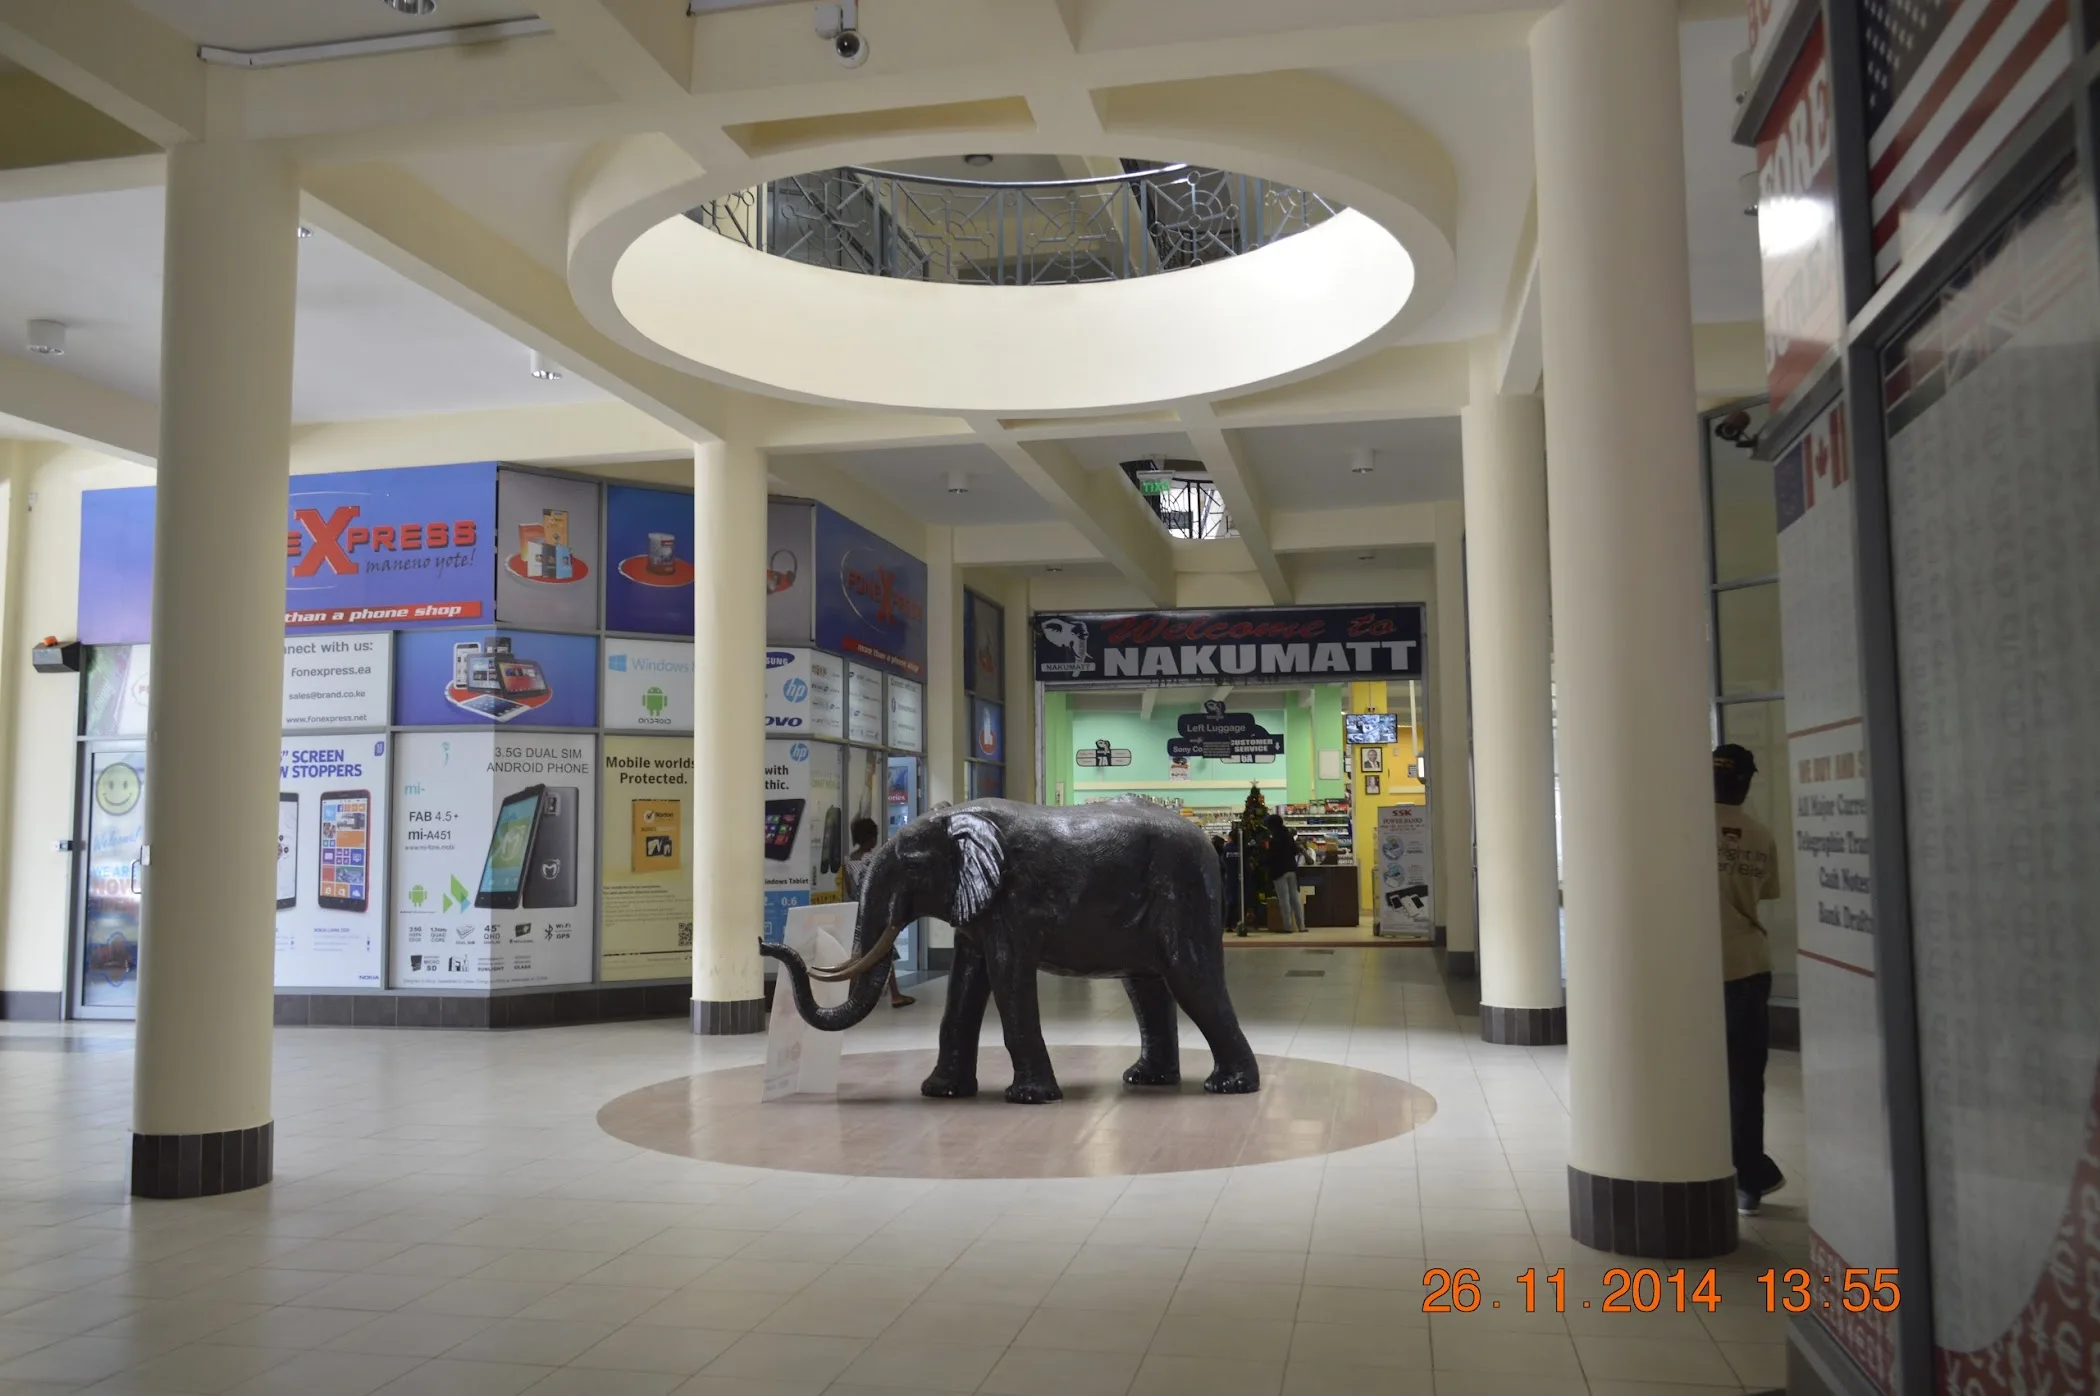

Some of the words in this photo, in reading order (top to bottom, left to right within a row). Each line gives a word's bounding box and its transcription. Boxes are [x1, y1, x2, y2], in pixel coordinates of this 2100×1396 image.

[366, 557, 431, 574] maneno
[436, 548, 476, 580] yote!
[284, 611, 326, 623] than
[332, 611, 344, 621] a
[350, 608, 408, 622] phone
[414, 605, 462, 618] shop
[1101, 614, 1327, 644] Welcome
[1348, 613, 1398, 636] to
[321, 642, 349, 653] with
[354, 642, 373, 652] us:
[1103, 640, 1417, 676] NAKUMATT
[632, 658, 689, 673] Windows
[291, 666, 372, 678] fonexpress.ea
[289, 690, 366, 700] sales@brand.co.ke
[784, 678, 807, 703] hp
[286, 714, 367, 724] www.fonexpress.net
[1186, 724, 1205, 733] Left
[1206, 724, 1246, 734] Luggage
[495, 747, 522, 758] 3.5G
[526, 747, 558, 759] DUAL
[561, 748, 582, 759] SIM
[790, 743, 808, 763] hp
[1173, 746, 1191, 754] Sony
[1234, 745, 1268, 753] SERVICE
[292, 749, 345, 763] SCREEN
[606, 756, 651, 768] Mobile
[292, 764, 363, 778] STOPPERS
[487, 762, 544, 773] ANDROID
[547, 763, 589, 774] PHONE
[764, 765, 789, 775] with
[620, 772, 688, 784] Protected.
[409, 811, 432, 822] FAB
[1391, 809, 1412, 817] SSK
[408, 828, 452, 840] mi-A451
[781, 896, 798, 906] 0.6
